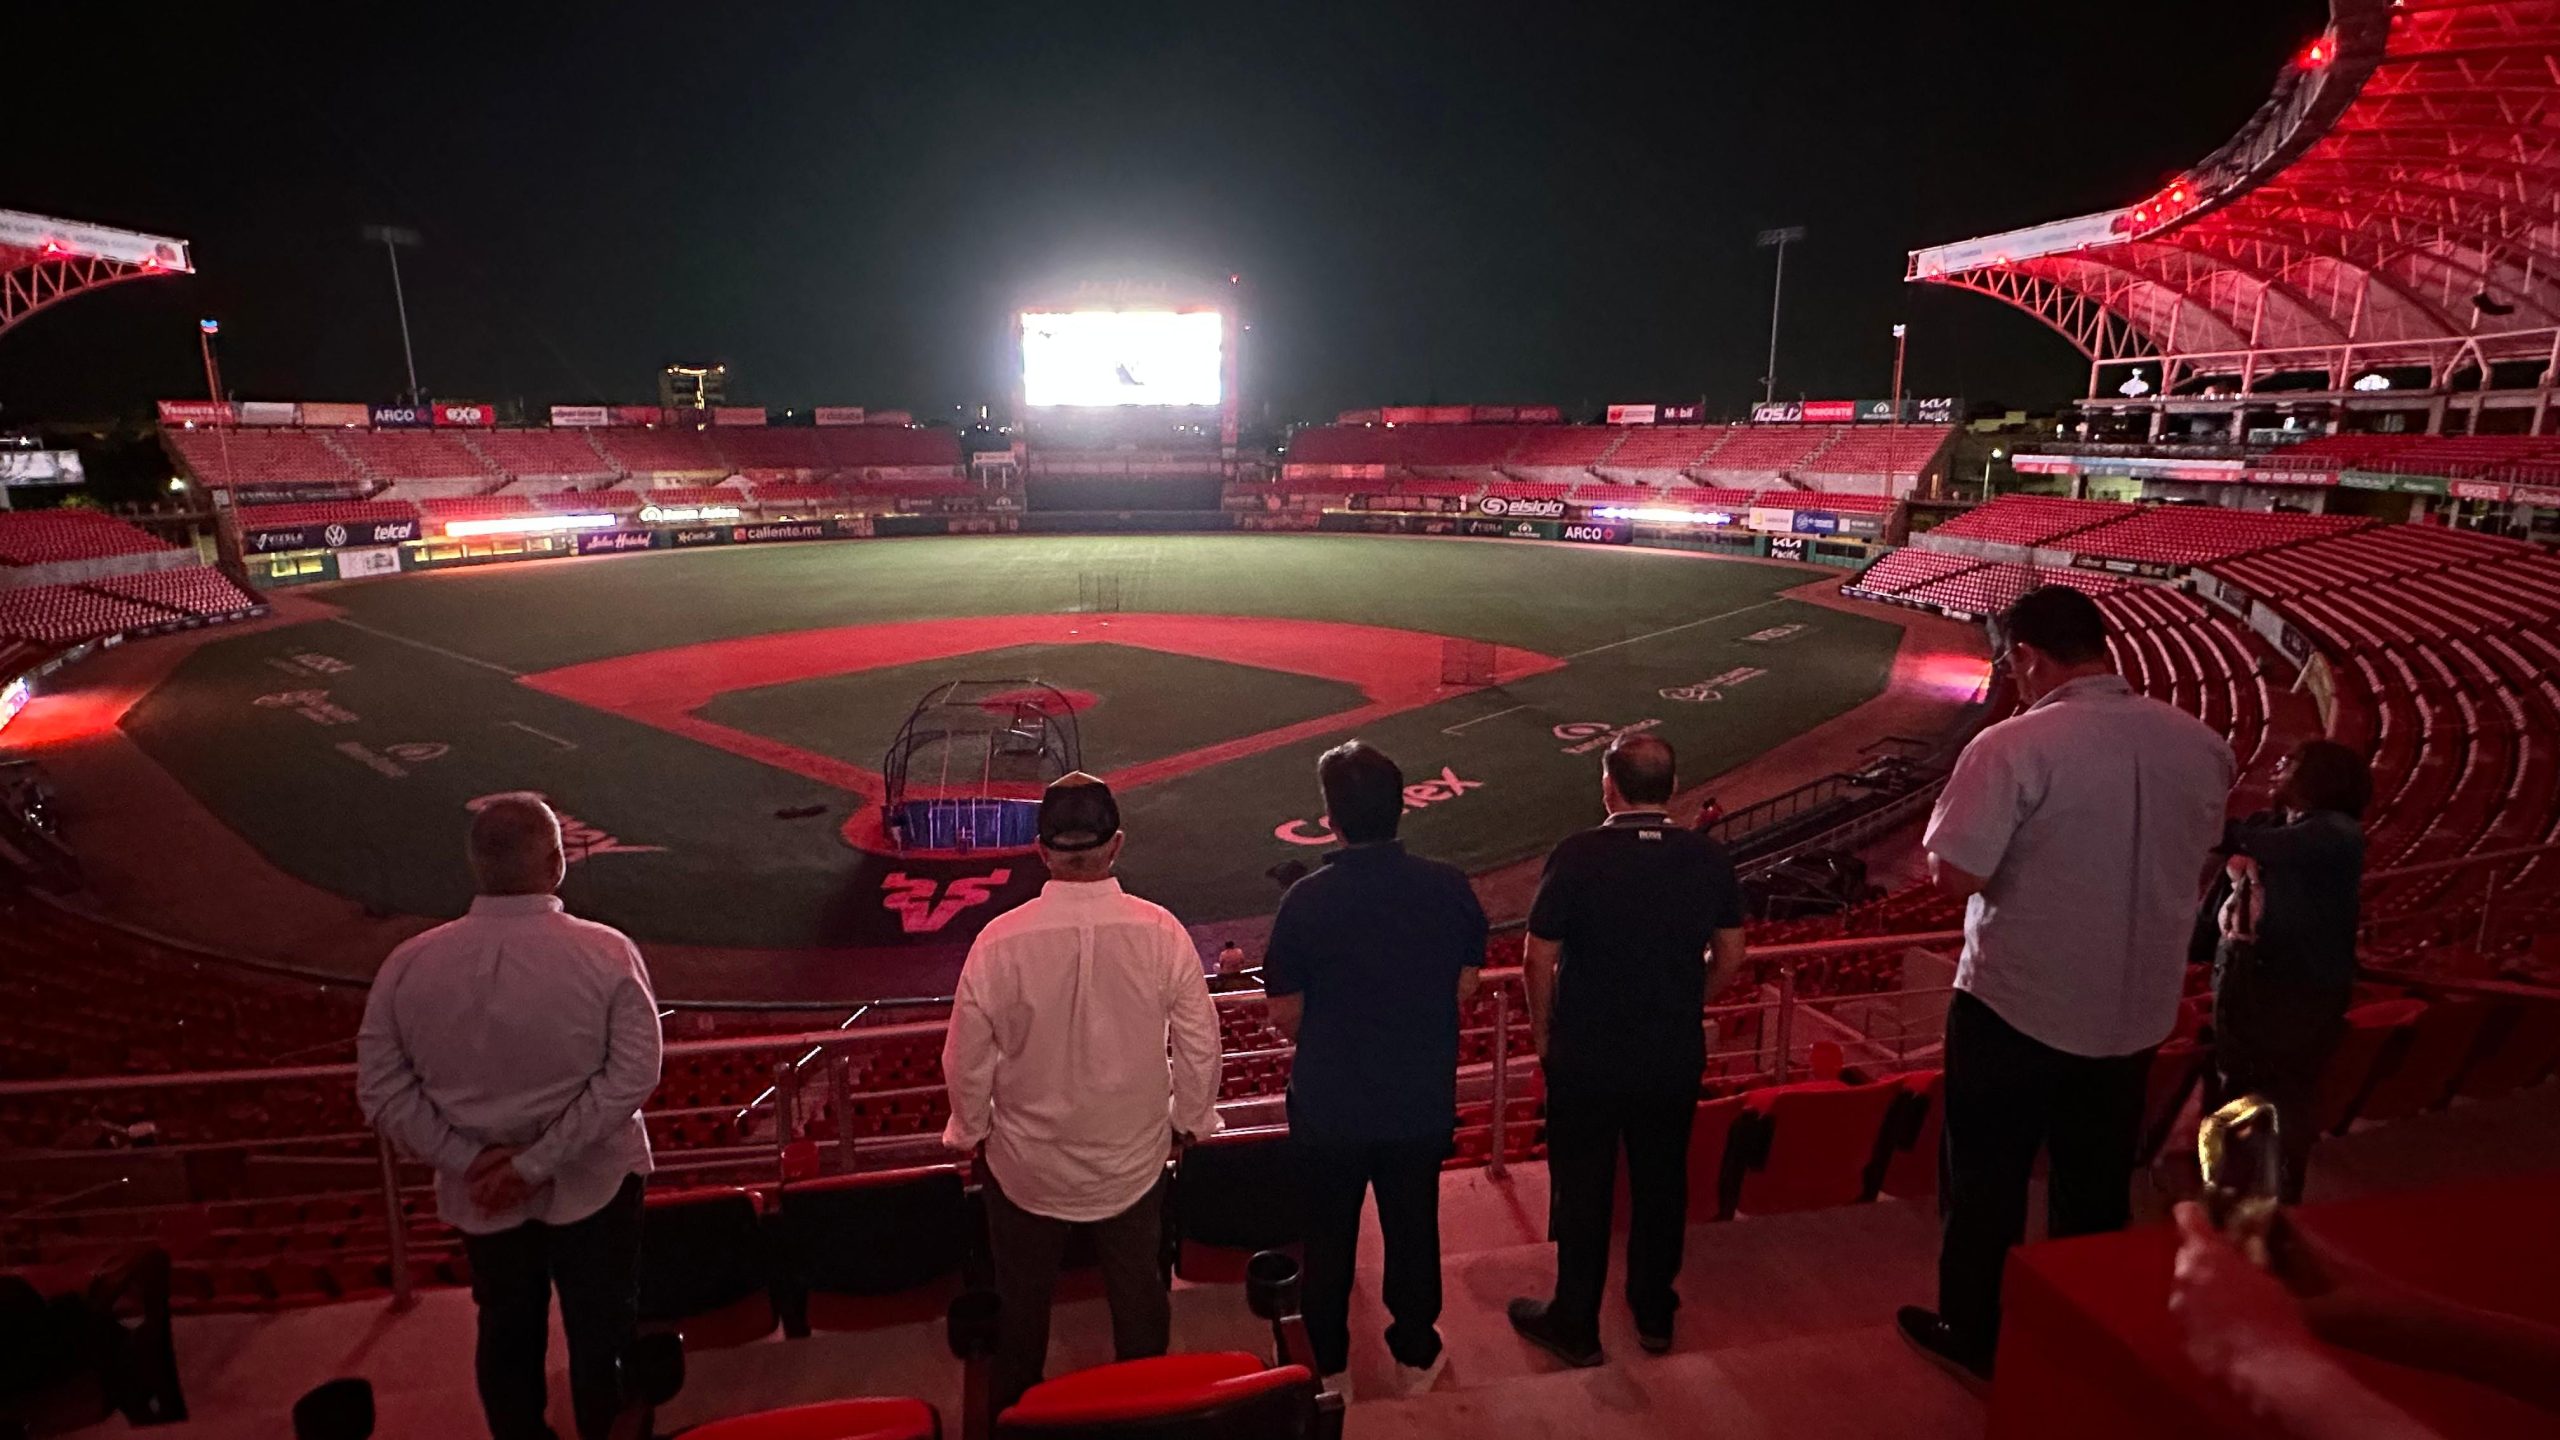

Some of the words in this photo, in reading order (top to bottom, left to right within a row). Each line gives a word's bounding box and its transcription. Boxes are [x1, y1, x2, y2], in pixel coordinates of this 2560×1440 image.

[375, 409, 415, 421] ARCO
[1665, 407, 1694, 418] Mobil
[1919, 409, 1949, 421] Pacific
[374, 522, 412, 541] telcel
[747, 525, 823, 540] caliente.mx
[1565, 526, 1601, 540] ARCO
[1772, 538, 1802, 548] KIA
[1771, 548, 1801, 560] Pacific
[1274, 766, 1484, 845] Cex
